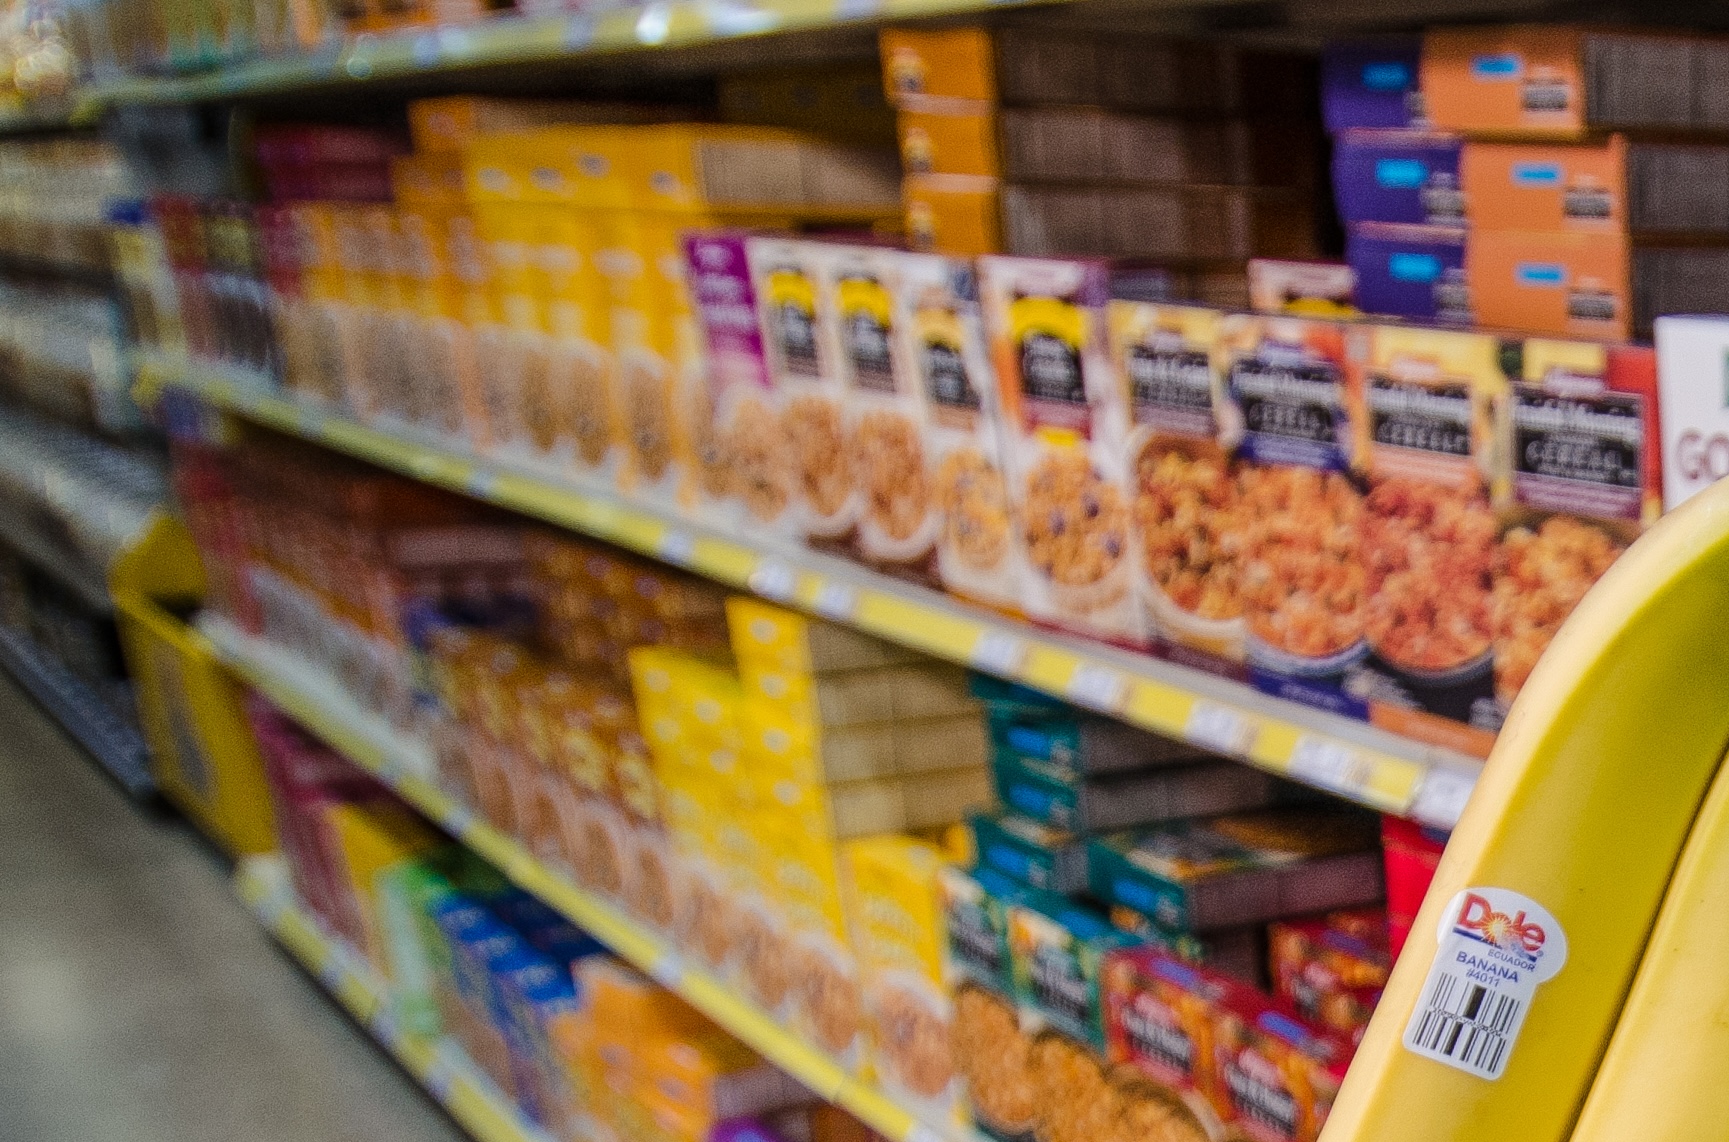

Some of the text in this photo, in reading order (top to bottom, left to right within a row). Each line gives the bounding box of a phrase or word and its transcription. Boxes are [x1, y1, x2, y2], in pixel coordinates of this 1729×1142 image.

[1457, 892, 1546, 953] Dole
[1455, 951, 1519, 983] BANANA
[1488, 948, 1537, 972] ECUADOR
[1466, 969, 1500, 987] #4011
